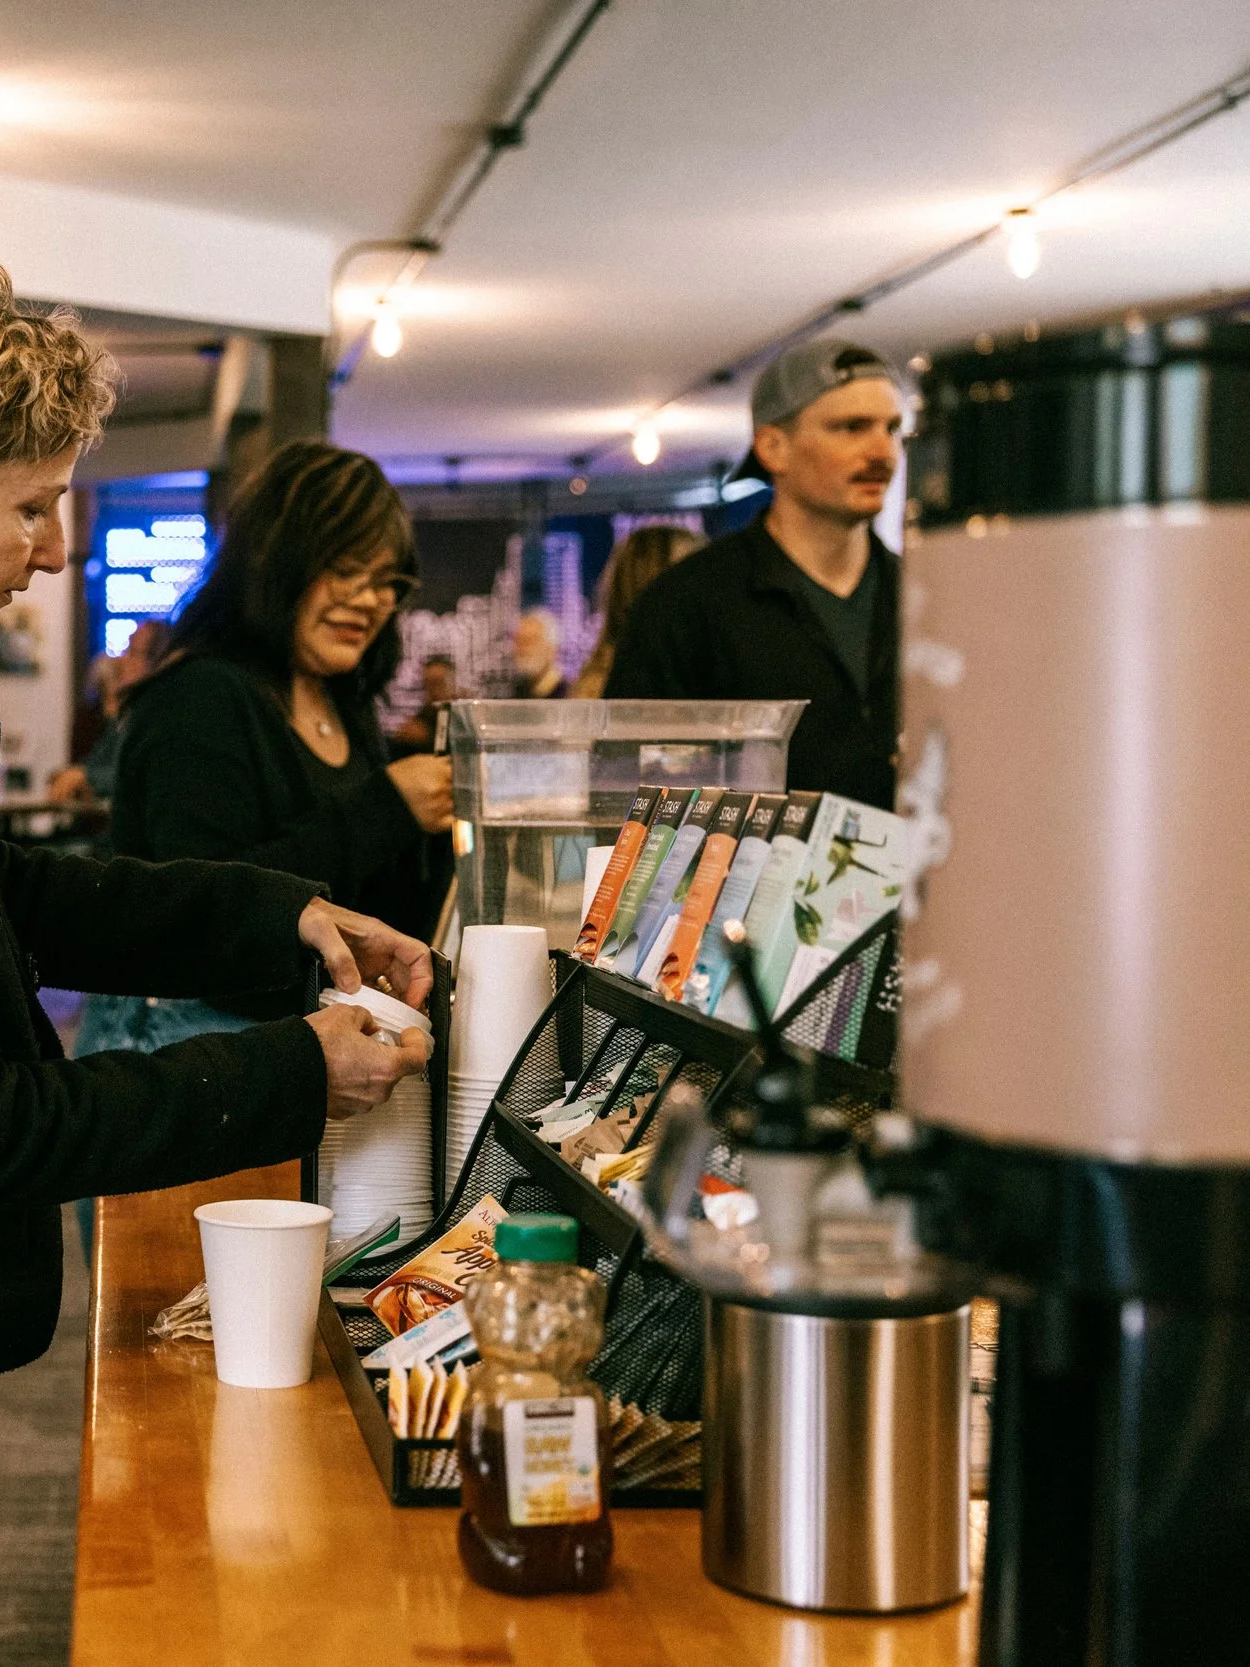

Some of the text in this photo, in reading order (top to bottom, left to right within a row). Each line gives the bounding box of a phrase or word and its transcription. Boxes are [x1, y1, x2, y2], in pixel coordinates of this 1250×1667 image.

[633, 798, 650, 811] STASH
[663, 801, 681, 814] STASH
[693, 801, 713, 814] STASH
[719, 807, 740, 821] STASH
[753, 808, 774, 824] STASH
[478, 1209, 497, 1231] ALP
[441, 1245, 498, 1270] App
[412, 1277, 458, 1299] ORIGINAL
